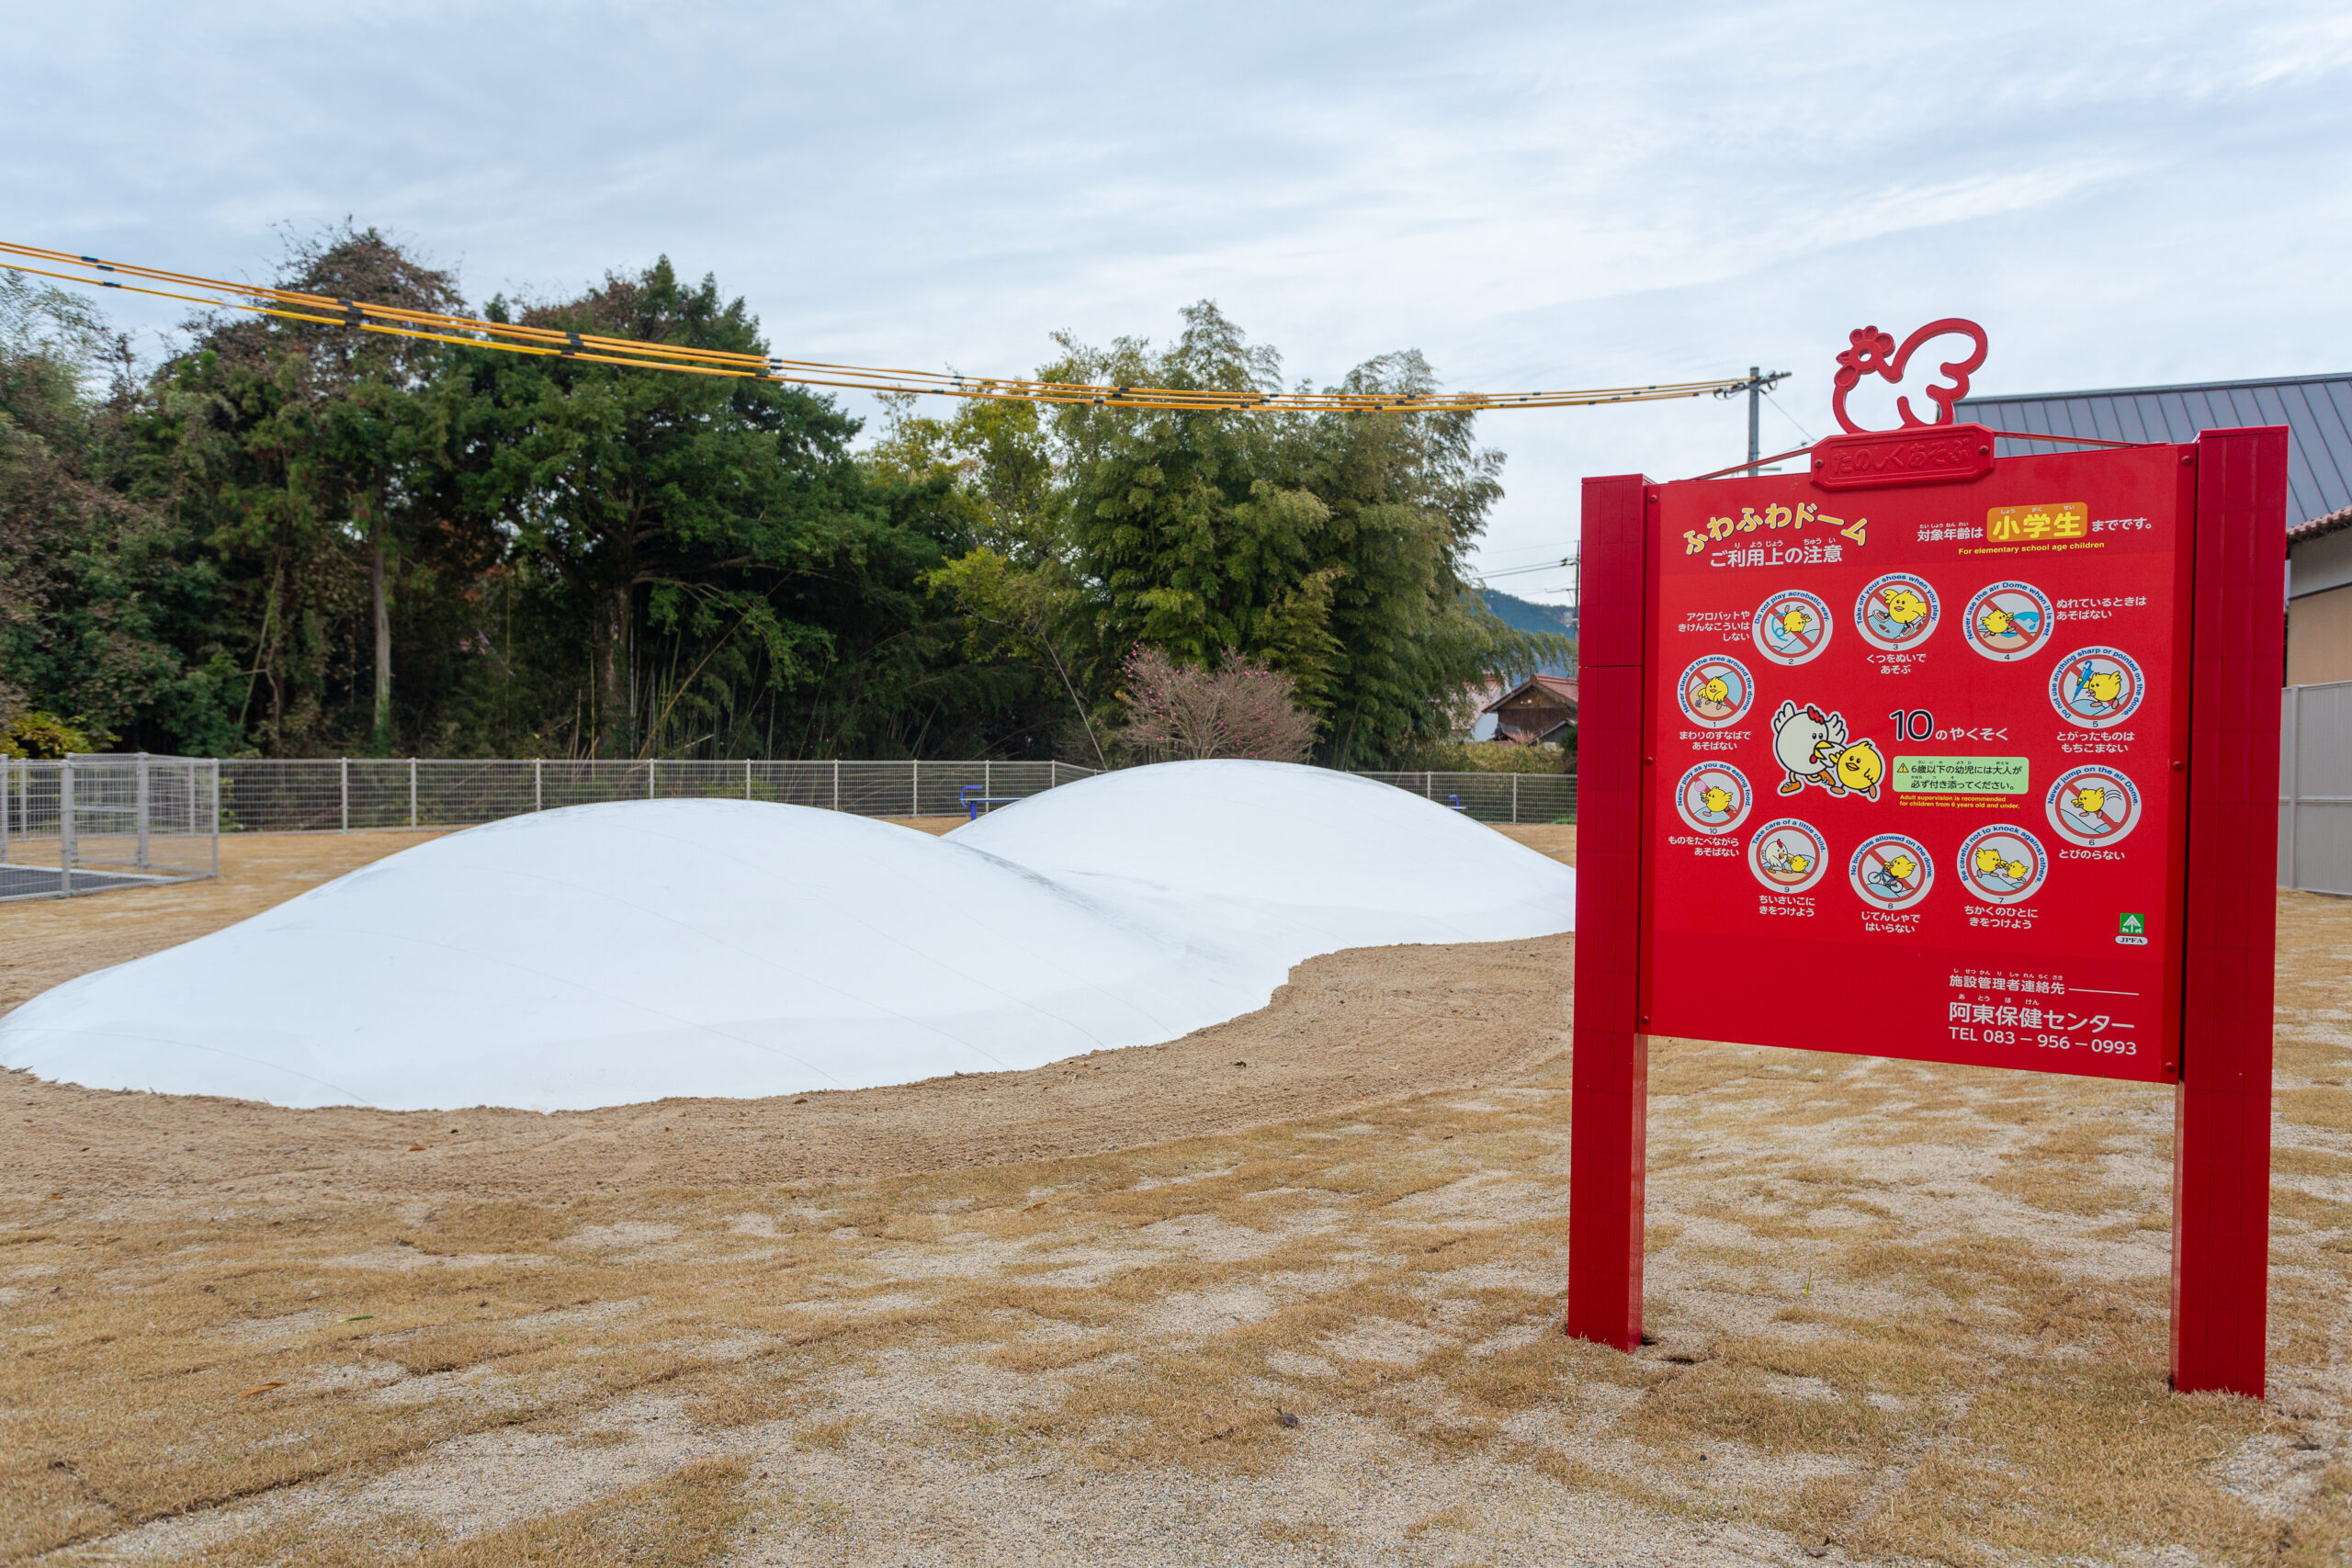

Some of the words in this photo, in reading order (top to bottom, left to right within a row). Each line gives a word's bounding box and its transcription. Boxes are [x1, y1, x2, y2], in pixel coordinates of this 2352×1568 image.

[1683, 502, 1868, 556] ふわふわドーム
[1973, 545, 2019, 555] elementary
[2021, 544, 2050, 553] school
[2052, 544, 2067, 552] age
[2069, 541, 2105, 550] children
[1710, 544, 1843, 568] ご利用上の注意
[2056, 596, 2147, 609] ぬれているときは
[1686, 610, 1750, 622] アクロバットや
[2056, 610, 2113, 621] あそばない
[1678, 622, 1750, 632] きけんなこういは
[1723, 632, 1750, 642] しない
[1866, 653, 1927, 663] くつをぬいで
[1880, 664, 1911, 674] あそぶ
[1888, 708, 2008, 742] 10のやくそく
[1679, 731, 1752, 740] まわりのすなばで
[2056, 731, 2135, 741] とがったものは
[1691, 741, 1737, 750] あそばない
[2061, 743, 2129, 753] もちこまない
[1911, 764, 2023, 775] 6歳以下の幼児には大人が
[1668, 836, 1739, 847] ものをたべながら
[1694, 847, 1739, 857] あそばない
[2058, 849, 2125, 860] とびのらない
[1758, 894, 1815, 906] ちいさいこに
[1758, 905, 1815, 918] きをつけよう
[1860, 910, 1921, 923] じてんしゃで
[1964, 905, 2039, 919] ちかくのひとに
[1865, 922, 1916, 933] はいらない
[1969, 917, 2032, 930] きをつけよう
[1949, 974, 2065, 995] 施設管理者連絡先
[1949, 1001, 2135, 1033] 阿東保健センター
[1948, 1026, 1978, 1042] TEL
